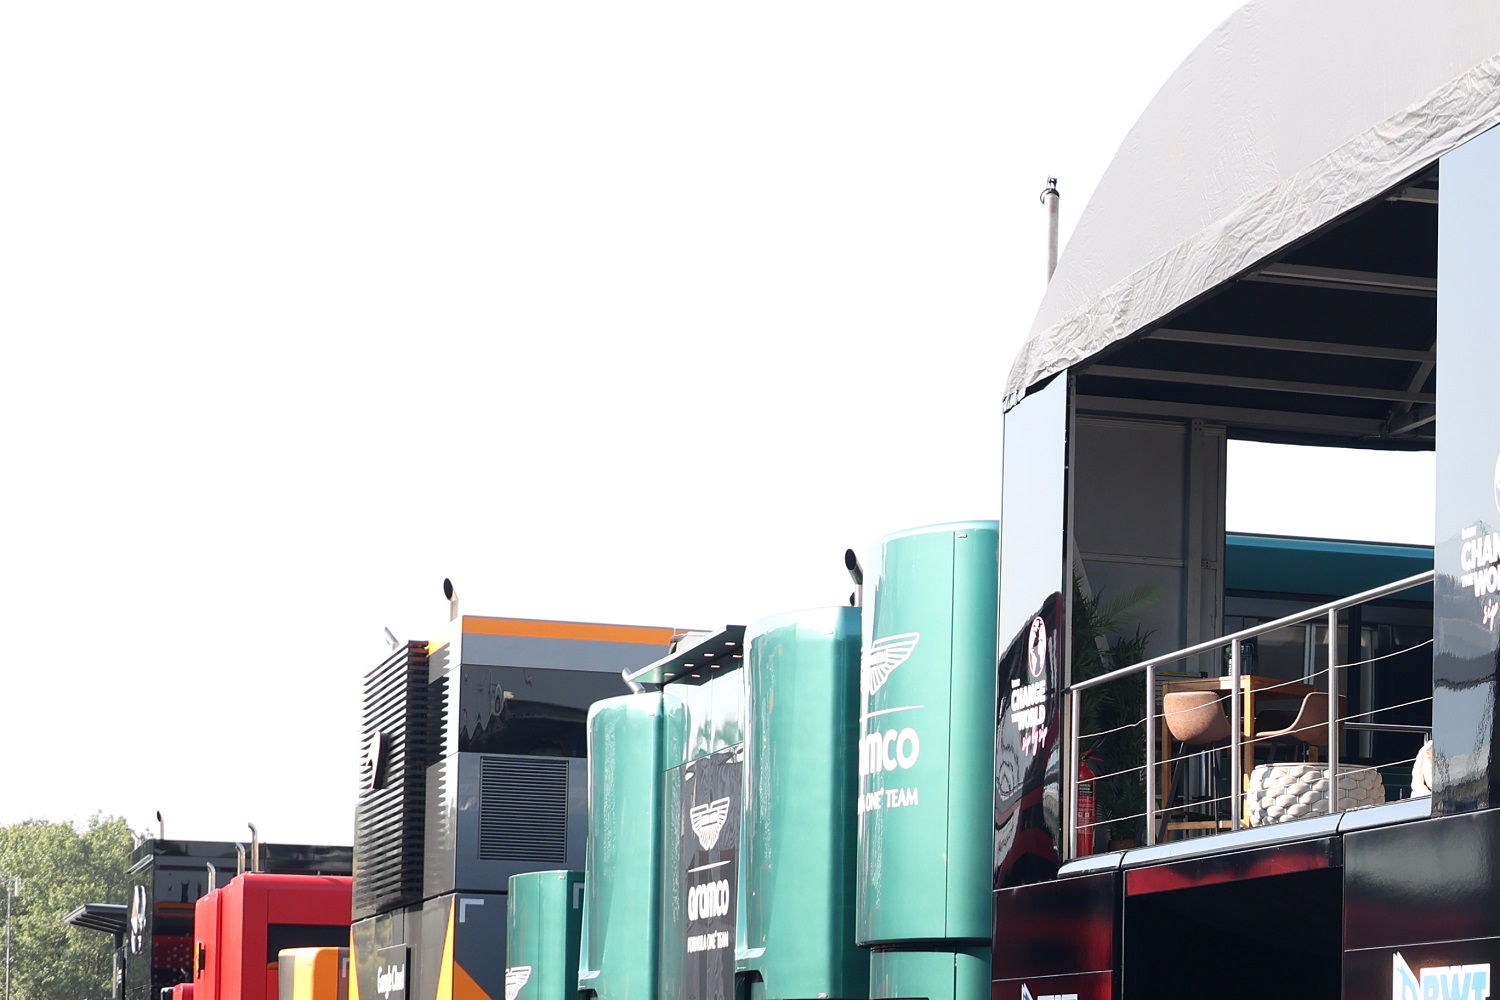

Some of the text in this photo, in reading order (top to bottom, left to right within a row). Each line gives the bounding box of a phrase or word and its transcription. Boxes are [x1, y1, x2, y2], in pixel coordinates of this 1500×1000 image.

[1011, 679, 1046, 712] CHANGE
[885, 787, 919, 808] TEAM
[688, 879, 729, 921] aramco
